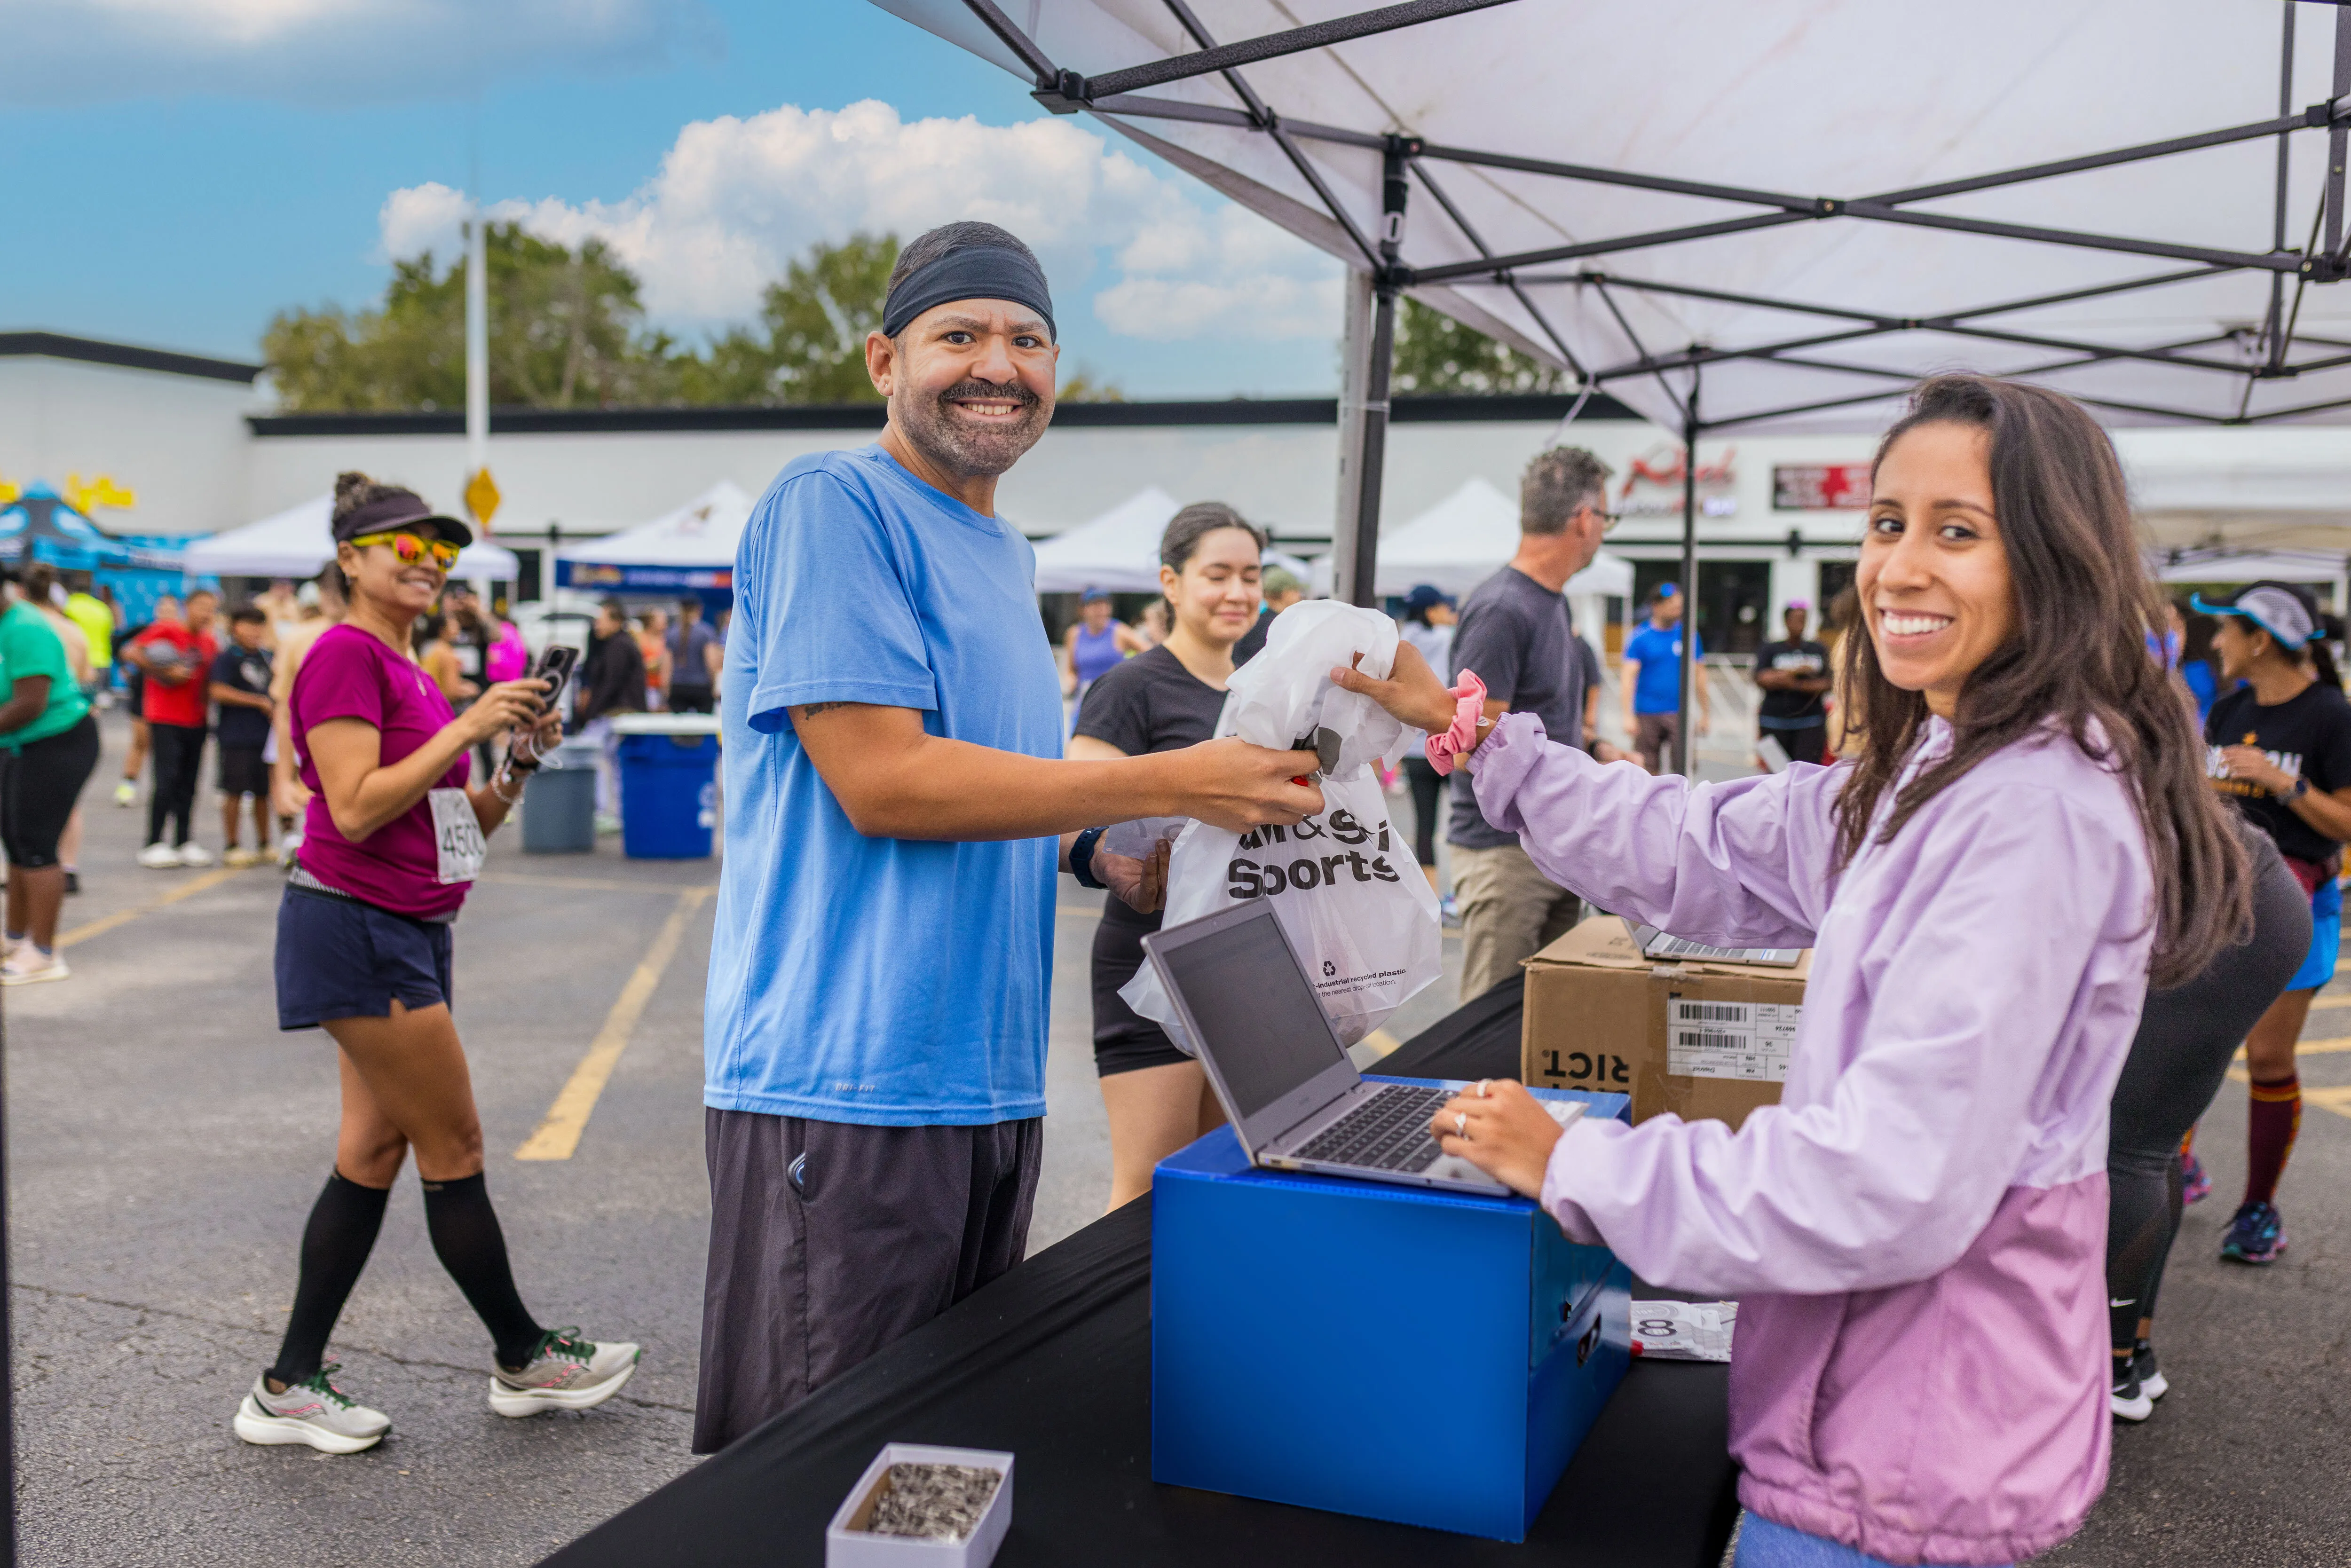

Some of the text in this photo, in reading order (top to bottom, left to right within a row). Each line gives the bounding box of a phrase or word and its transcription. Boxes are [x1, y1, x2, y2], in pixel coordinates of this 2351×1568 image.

[1292, 815, 1329, 840] &
[1228, 850, 1401, 898] Sports
[1350, 973, 1377, 983] recycled
[1332, 987, 1352, 995] nearest
